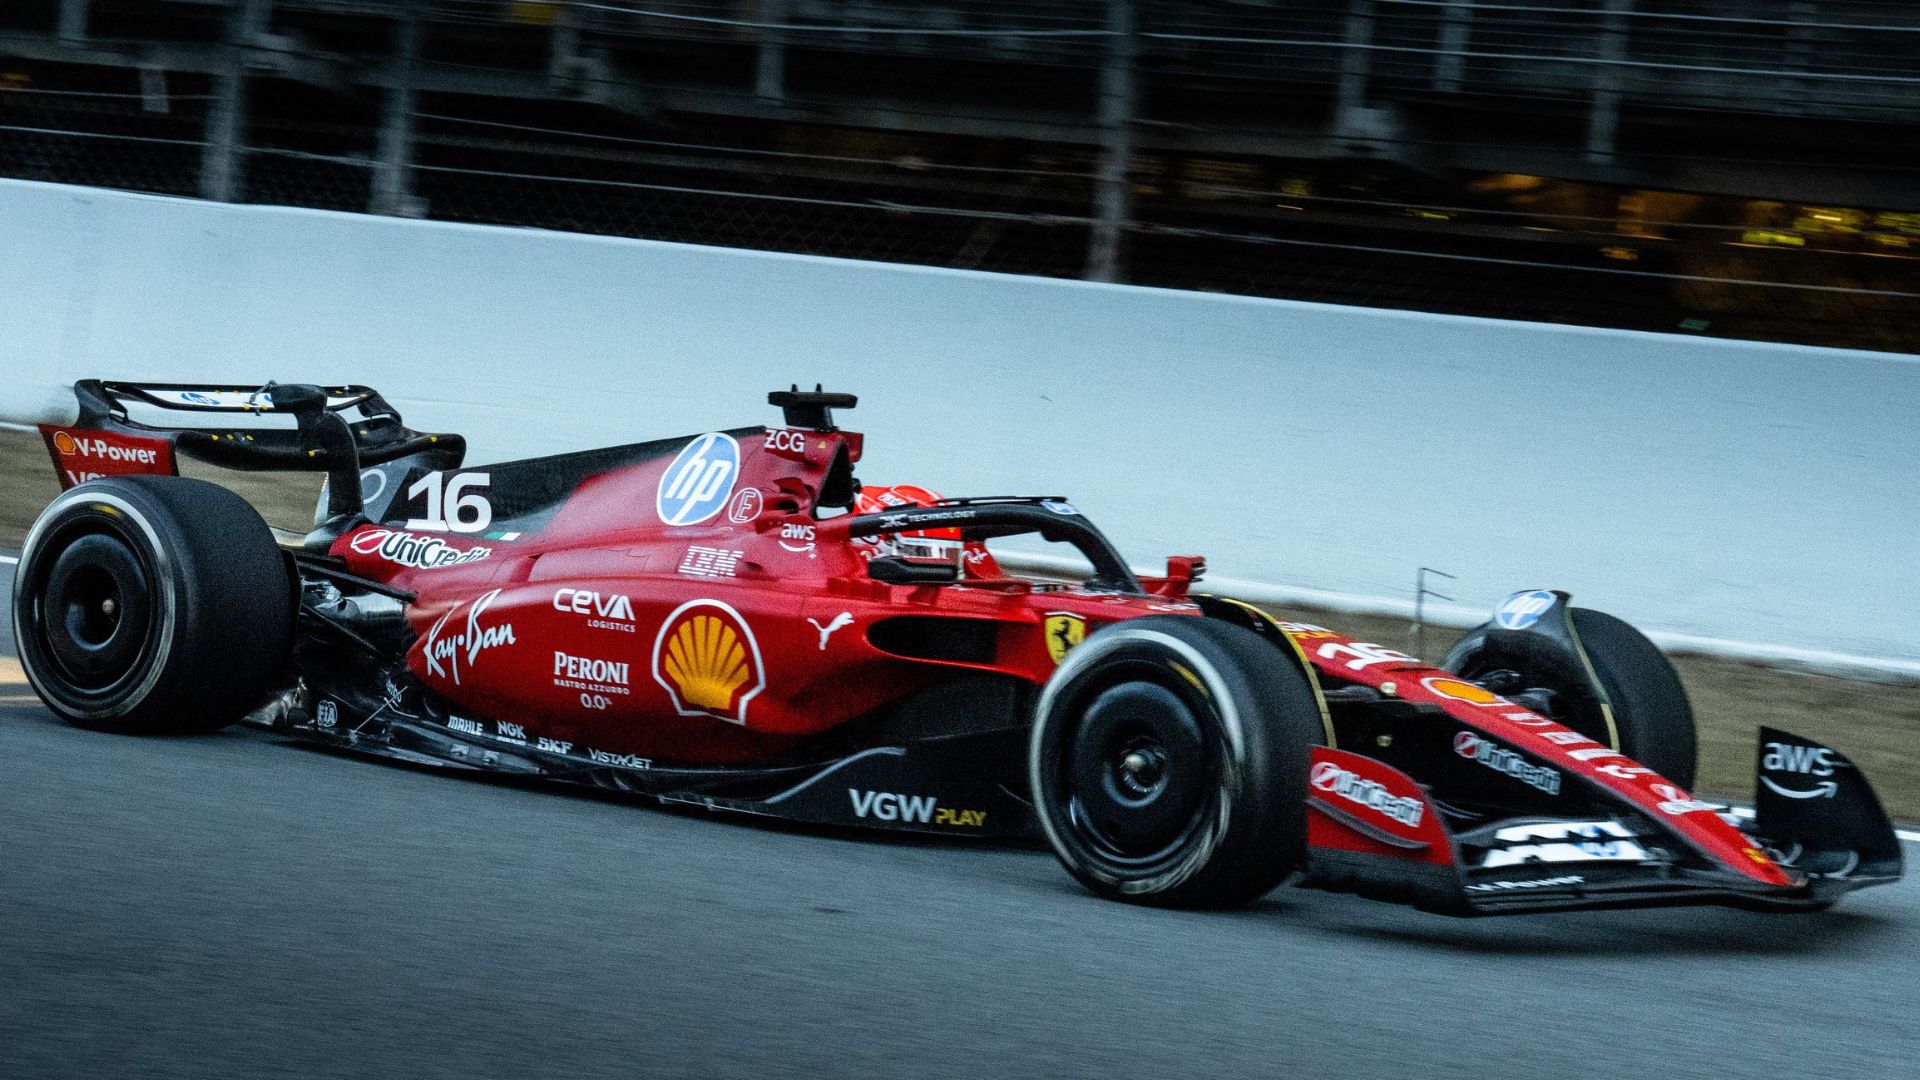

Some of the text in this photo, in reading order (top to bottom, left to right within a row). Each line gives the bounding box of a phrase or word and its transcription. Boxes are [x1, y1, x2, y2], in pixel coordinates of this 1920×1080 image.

[73, 437, 156, 464] V-Power
[764, 429, 805, 452] ZCG
[663, 434, 734, 524] hp
[405, 471, 492, 533] 16
[781, 523, 816, 541] aws
[381, 532, 492, 568] UniCredit
[678, 545, 744, 577] IBM
[553, 588, 636, 621] CEVA
[588, 619, 636, 633] LOGISTICS
[554, 651, 629, 685] PERONI
[554, 678, 630, 695] NASTRO AZZURRO
[318, 702, 336, 725] FIA
[447, 715, 484, 736] MAHLE
[497, 720, 527, 740] NGK
[537, 736, 574, 755] SKF
[1763, 742, 1835, 776] aws
[848, 789, 987, 826] VGW PLAY
